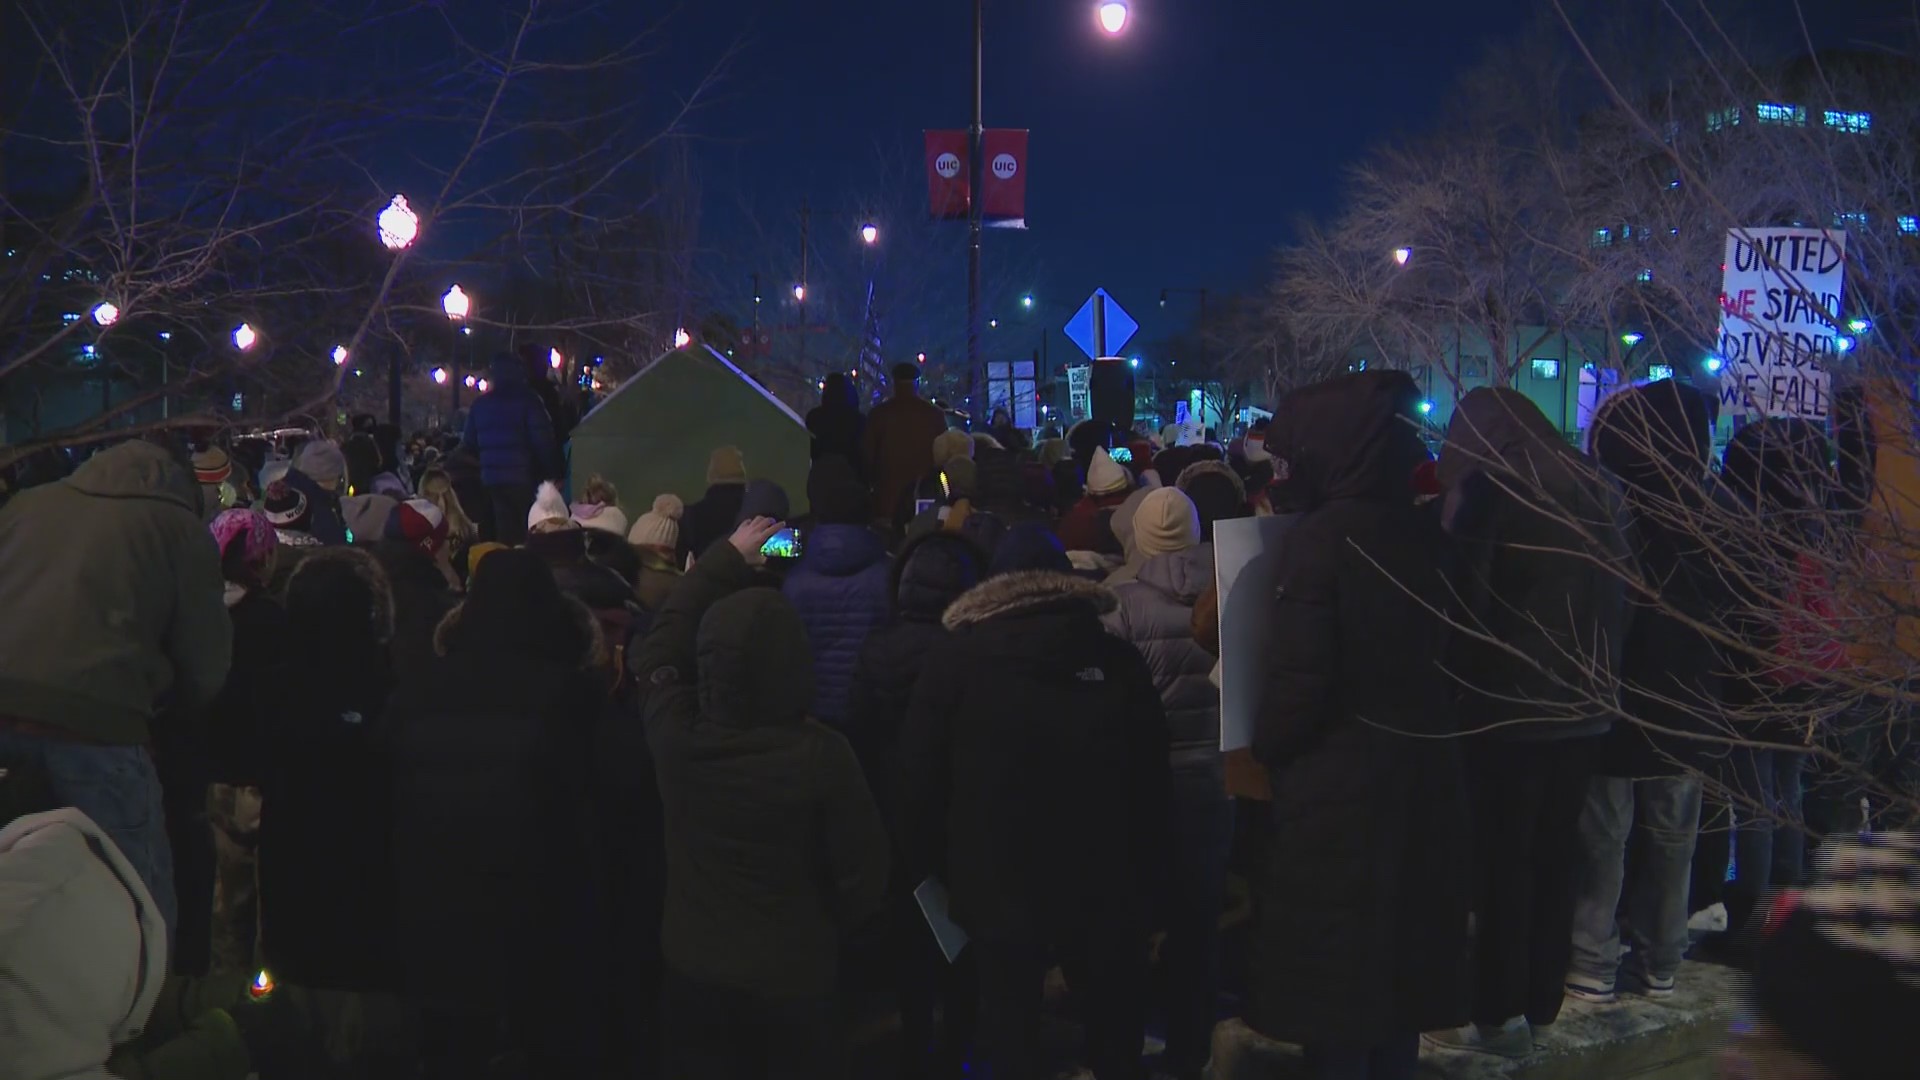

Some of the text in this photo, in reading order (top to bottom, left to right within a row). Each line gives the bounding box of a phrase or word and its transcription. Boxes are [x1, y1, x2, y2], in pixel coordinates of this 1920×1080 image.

[938, 160, 957, 171] UIC
[994, 161, 1015, 172] UIC
[1735, 236, 1840, 274] UNITED
[1719, 288, 1840, 328] WE STAND
[1720, 375, 1826, 416] WE FALL
